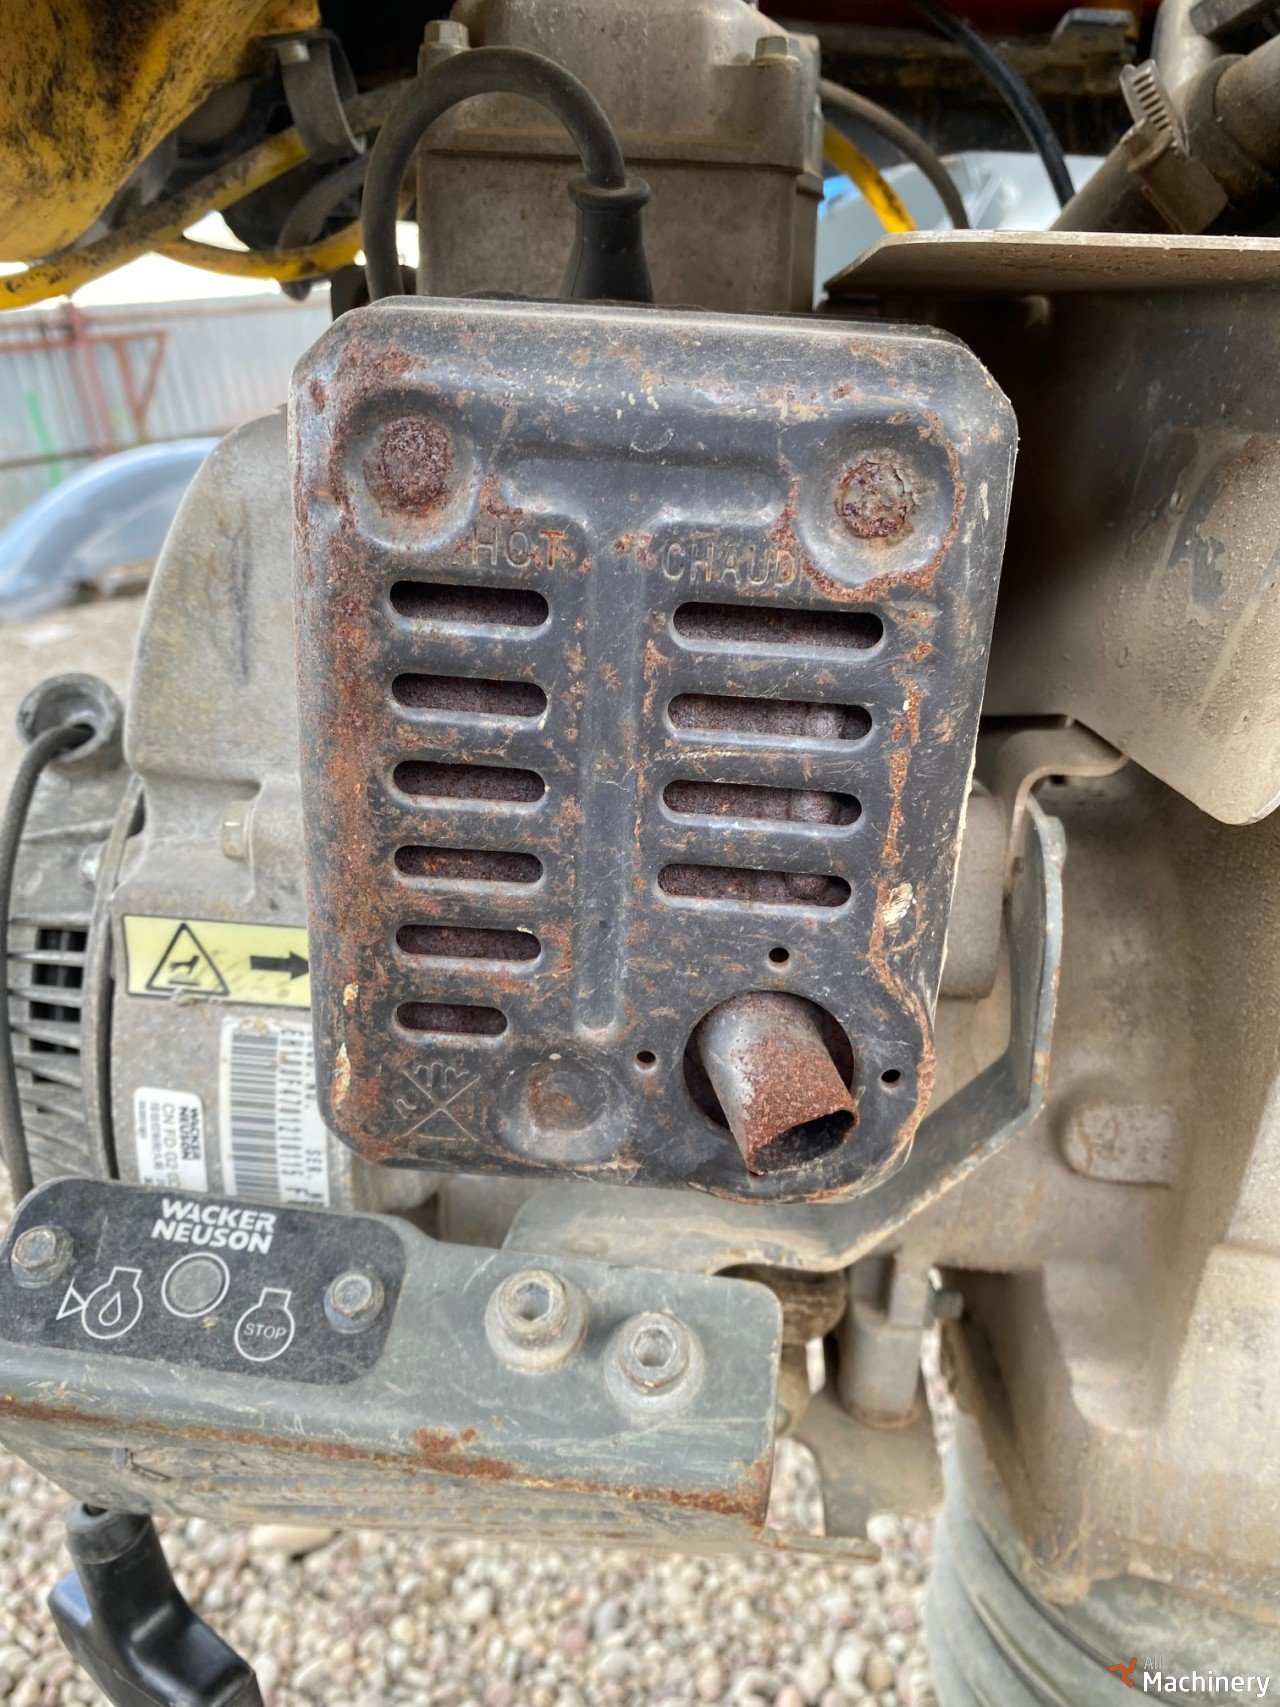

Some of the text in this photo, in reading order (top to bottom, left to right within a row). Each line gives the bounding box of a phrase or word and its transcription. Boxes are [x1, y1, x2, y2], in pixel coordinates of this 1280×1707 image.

[472, 528, 564, 570] HOT
[661, 540, 799, 587] CHAUD
[179, 1105, 190, 1160] NEUSON
[189, 1107, 201, 1161] WACKER
[150, 1219, 275, 1254] NEUSON
[160, 1198, 277, 1233] WACKER
[243, 1322, 288, 1340] STOP
